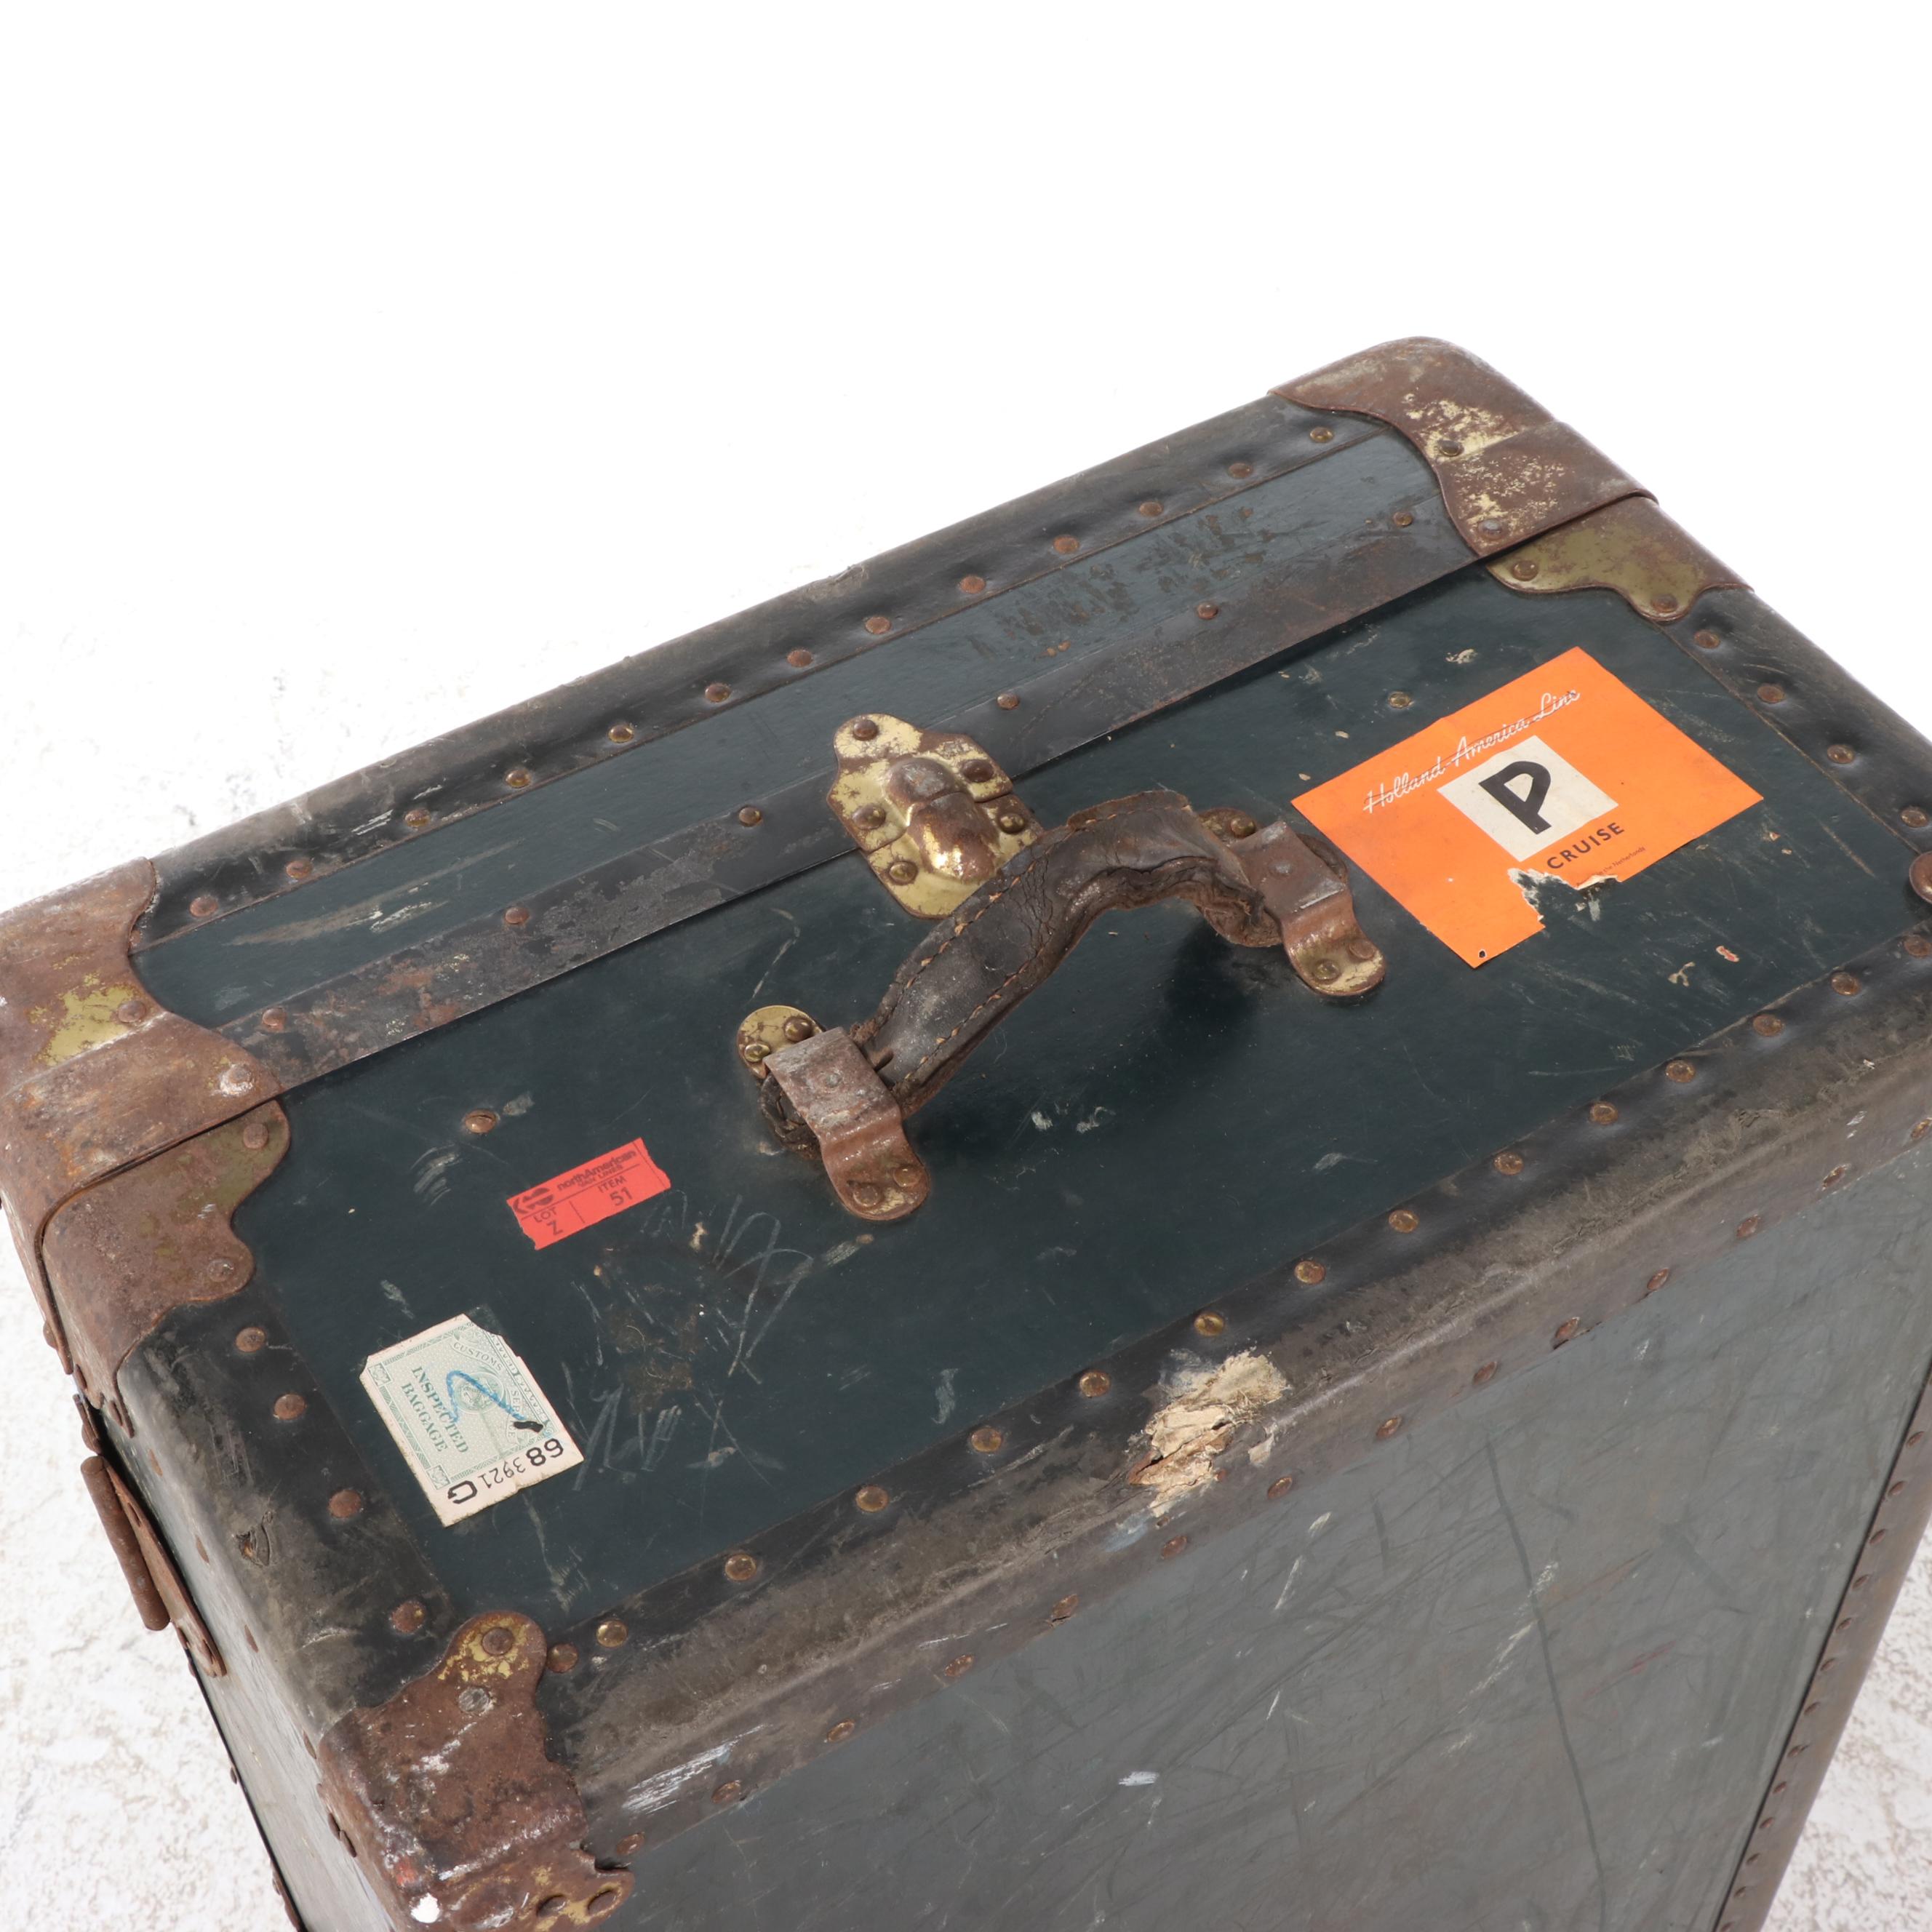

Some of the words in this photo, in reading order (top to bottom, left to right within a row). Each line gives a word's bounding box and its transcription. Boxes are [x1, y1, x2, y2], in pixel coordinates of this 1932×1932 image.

[1529, 688, 1581, 722] Line
[1478, 761, 1552, 835] P
[1547, 822, 1624, 869] CRUISE
[1612, 846, 1646, 867] Netherlands
[578, 1176, 597, 1188] VAN
[597, 1165, 623, 1181] LINES
[598, 1175, 626, 1193] ITEM
[610, 1187, 633, 1206] 51
[533, 1207, 558, 1223] LOT
[453, 1341, 503, 1371] CUSTOMS
[402, 1383, 448, 1452] BAGGAGE
[412, 1366, 469, 1453] INSPECTED
